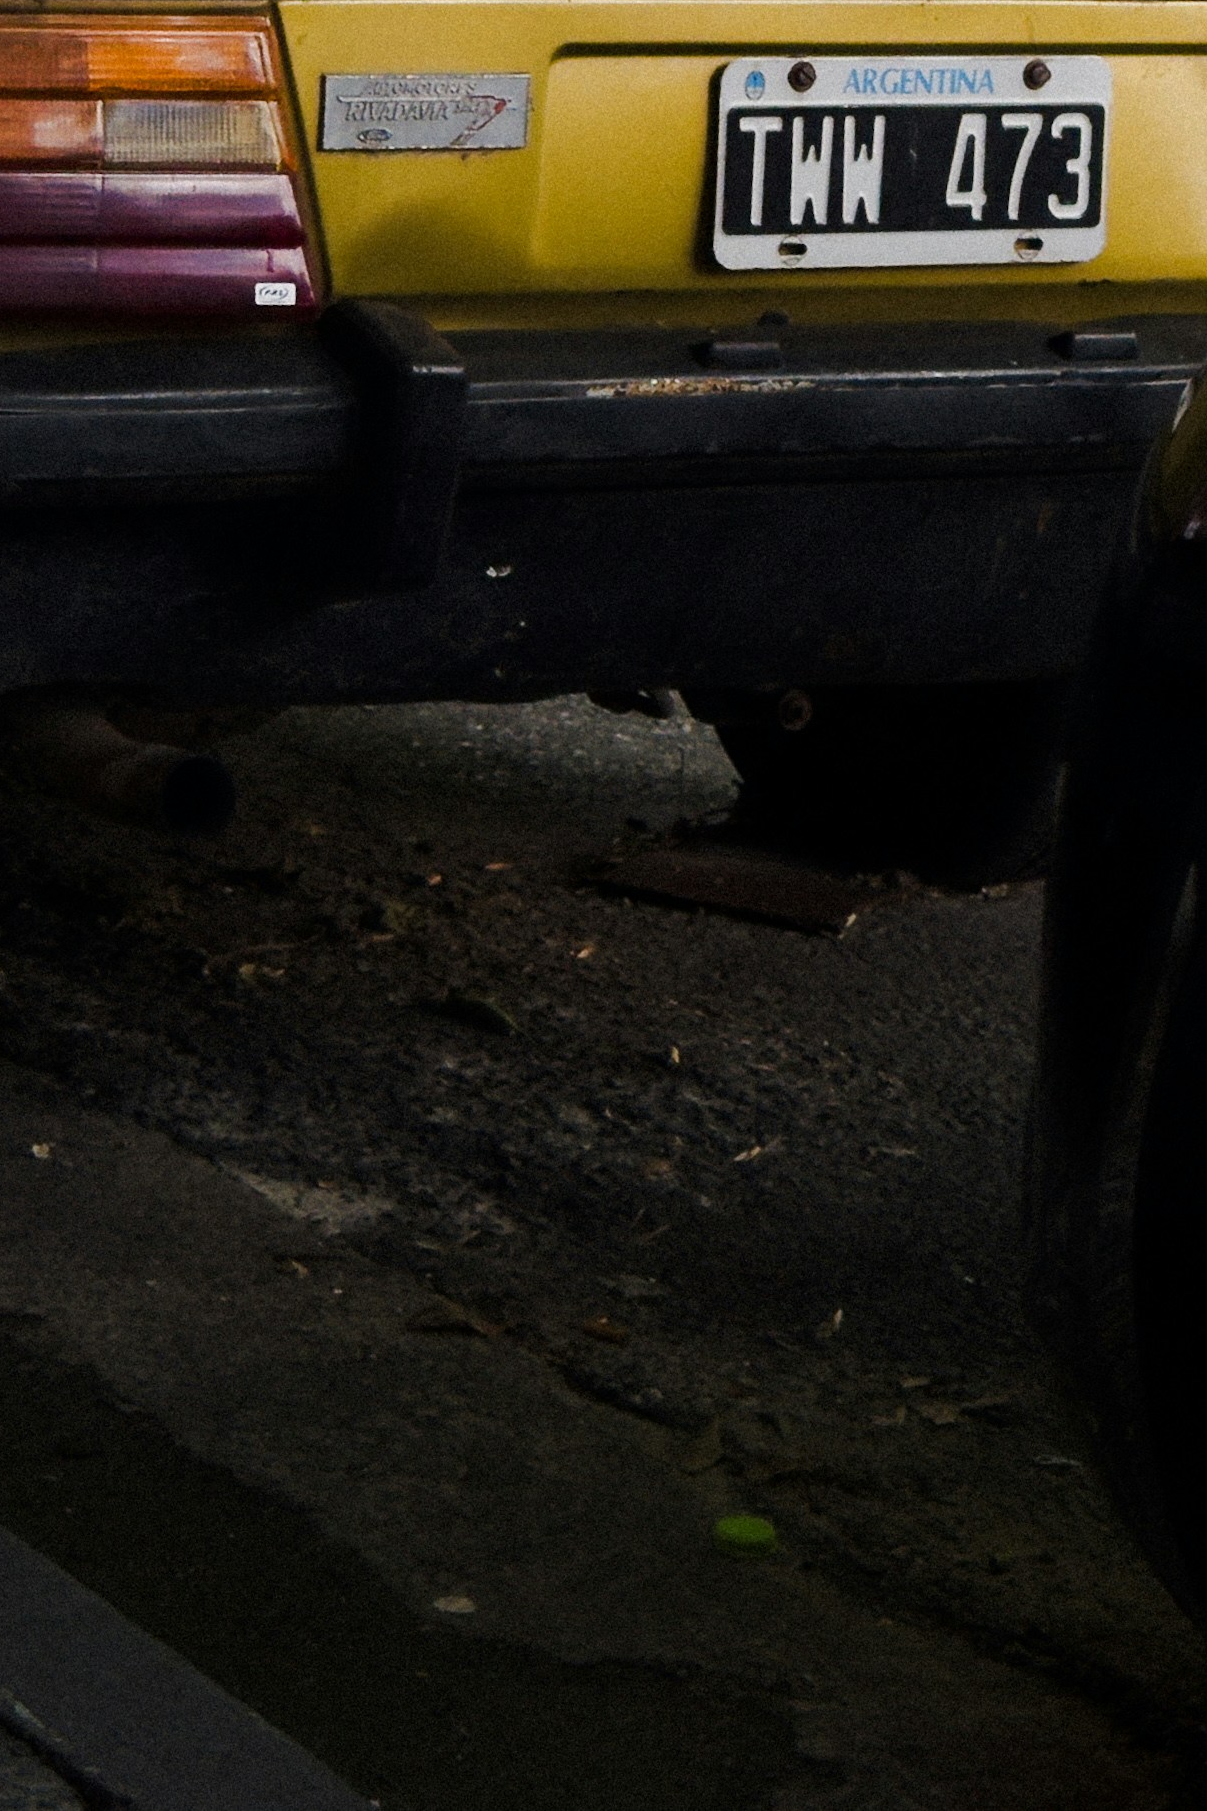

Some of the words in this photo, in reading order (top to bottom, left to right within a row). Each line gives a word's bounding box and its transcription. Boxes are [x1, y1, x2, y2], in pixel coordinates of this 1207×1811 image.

[843, 67, 994, 95] ARGENTINA
[739, 115, 886, 227] TWW
[945, 112, 1092, 222] 473
